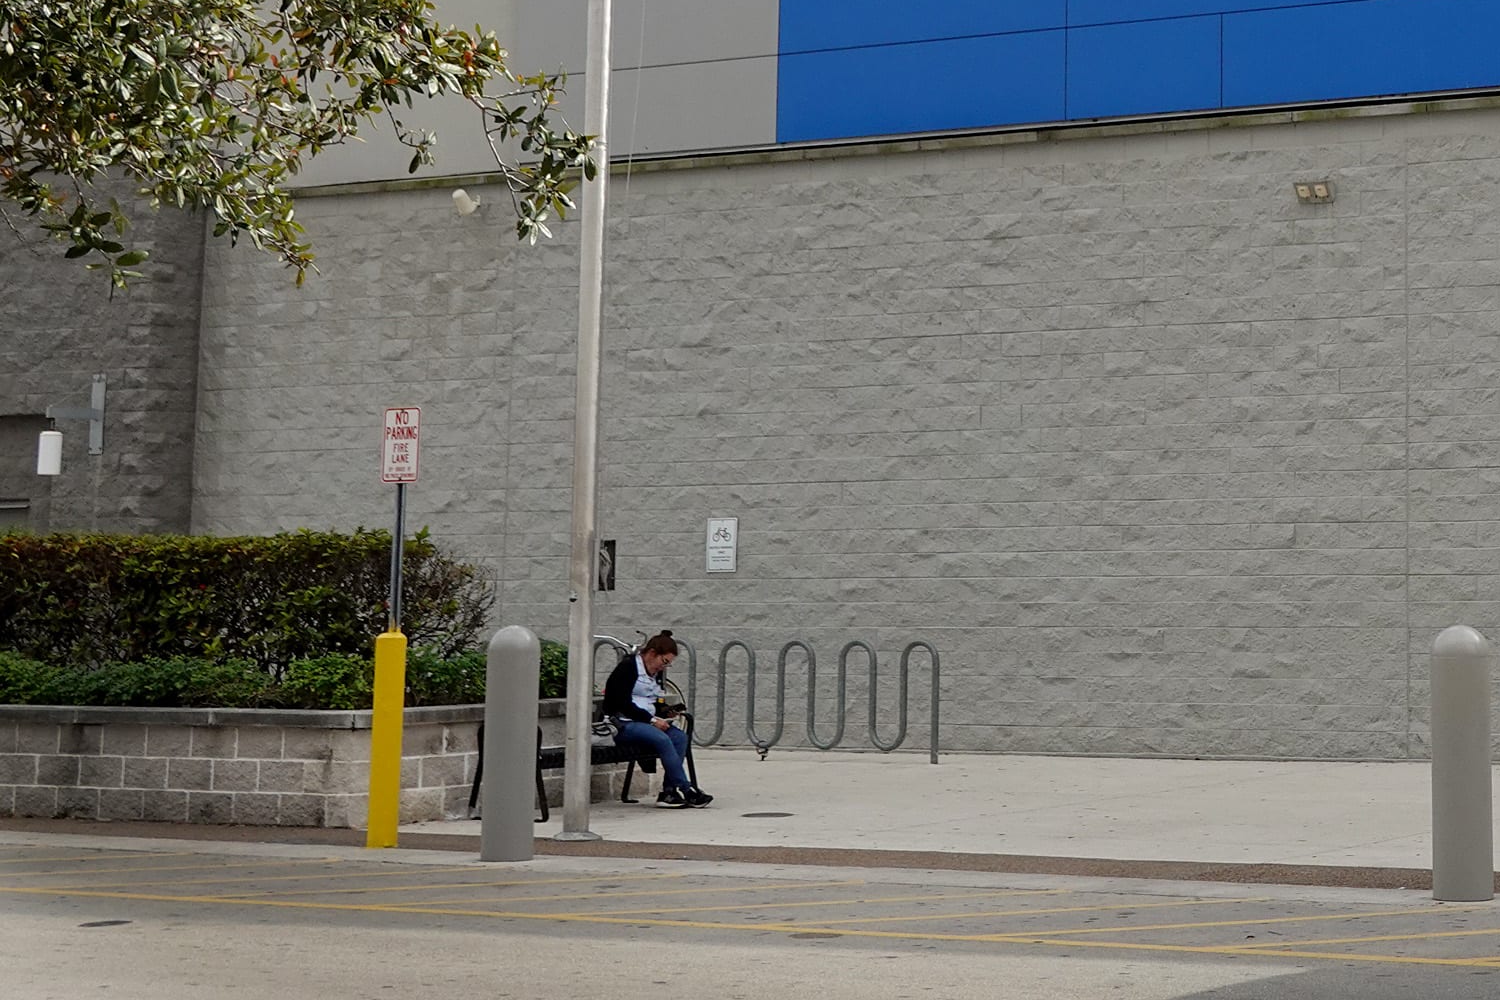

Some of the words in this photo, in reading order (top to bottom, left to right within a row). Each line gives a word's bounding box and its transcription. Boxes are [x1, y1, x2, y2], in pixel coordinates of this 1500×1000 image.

[395, 411, 409, 425] NO
[386, 426, 417, 440] PARKING
[393, 443, 409, 453] FIRE
[391, 454, 409, 464] LANE
